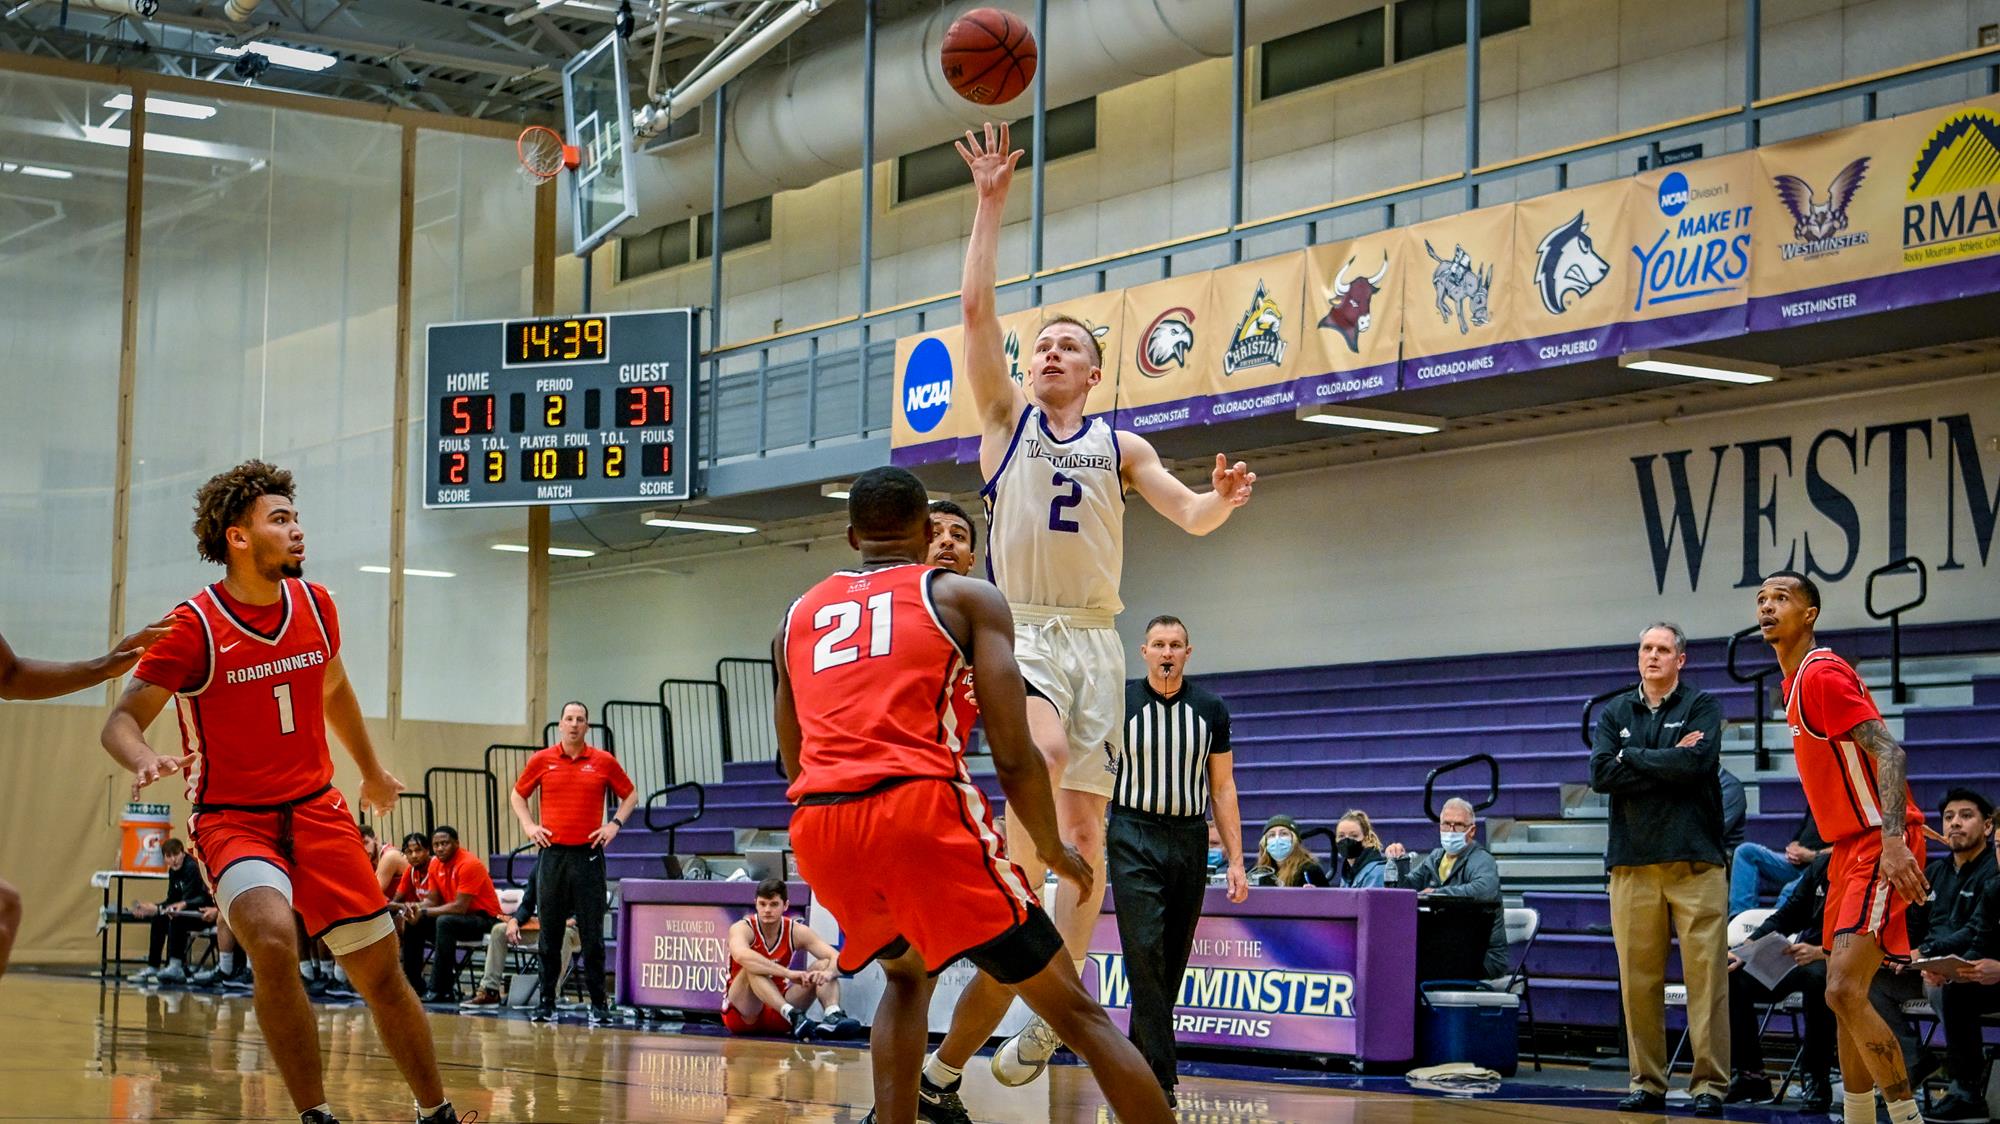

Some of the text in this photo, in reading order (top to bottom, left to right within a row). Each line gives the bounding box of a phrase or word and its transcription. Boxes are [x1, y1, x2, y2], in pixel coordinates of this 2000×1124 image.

[1661, 190, 1688, 208] NCAA
[1677, 206, 1753, 240] MAKE IT
[1903, 190, 2000, 246] RMA
[1777, 231, 1869, 261] WESTMINSTER
[1925, 246, 1956, 258] Mountain
[1632, 229, 1751, 312] YOURS
[1781, 293, 1857, 318] WESTMINSTER
[521, 319, 604, 360] 14:39
[1539, 338, 1598, 360] CSU-PUEBLO
[1223, 340, 1287, 376] CHRISTIAN
[1417, 355, 1494, 380] COLORADO MINES
[446, 372, 490, 392] HOME
[536, 378, 573, 393] PERIOD
[619, 362, 670, 383] GUEST
[1316, 375, 1384, 397] COLORADO MESA
[630, 386, 671, 426] 37
[907, 379, 951, 412] NCAA
[1212, 391, 1295, 415] COLORADO CHRISTIAN
[451, 396, 494, 435] 51
[546, 394, 563, 427] 2
[1133, 407, 1190, 427] CHADRON STATE
[439, 438, 471, 452] FOULS
[482, 436, 509, 451] T.O.L.
[520, 432, 590, 449] PLAYER FOUL
[600, 431, 629, 446] T.O.L.
[640, 429, 675, 444] FOULS
[450, 454, 465, 484] 2
[488, 451, 503, 483] 3
[533, 449, 558, 480] 10
[577, 449, 584, 477] 1
[606, 446, 622, 477] 2
[663, 446, 669, 473] 1
[1026, 439, 1112, 471] WTMINSTER
[438, 489, 470, 504] SCORE
[537, 485, 573, 500] MATCH
[639, 481, 674, 496] SCORE
[1048, 471, 1082, 533] 2
[812, 591, 893, 675] 21
[226, 649, 324, 684] ROADRUNNERS
[273, 682, 296, 736] 1
[666, 919, 715, 934] WELCOME TO
[654, 935, 726, 963] BEHNKEN
[1190, 938, 1262, 959] ME OF THE
[641, 963, 728, 993] FIELD HOUS
[1086, 952, 1356, 1018] WTMINSTER
